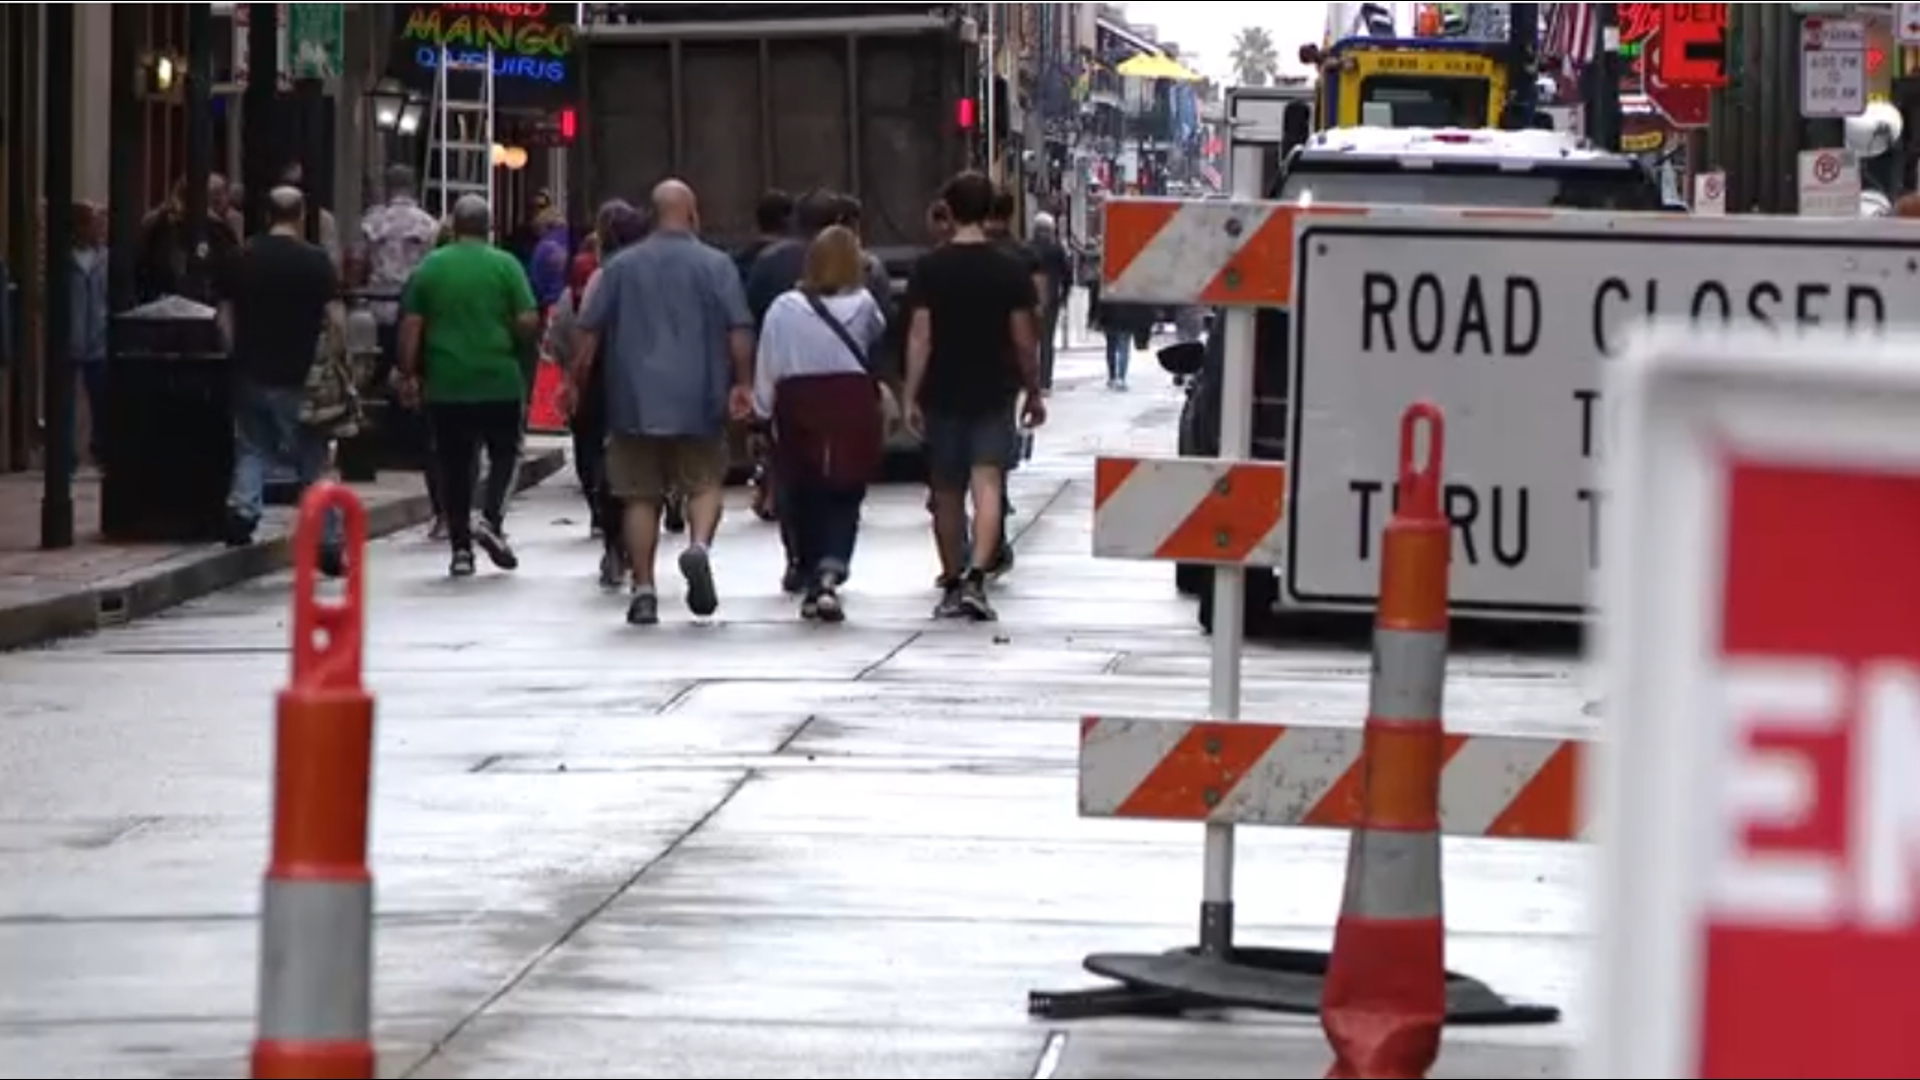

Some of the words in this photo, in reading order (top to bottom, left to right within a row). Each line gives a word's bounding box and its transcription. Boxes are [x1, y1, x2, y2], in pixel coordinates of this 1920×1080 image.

[401, 8, 572, 56] MANGO
[1362, 271, 1541, 355] ROAD
[1350, 480, 1528, 568] TRU
